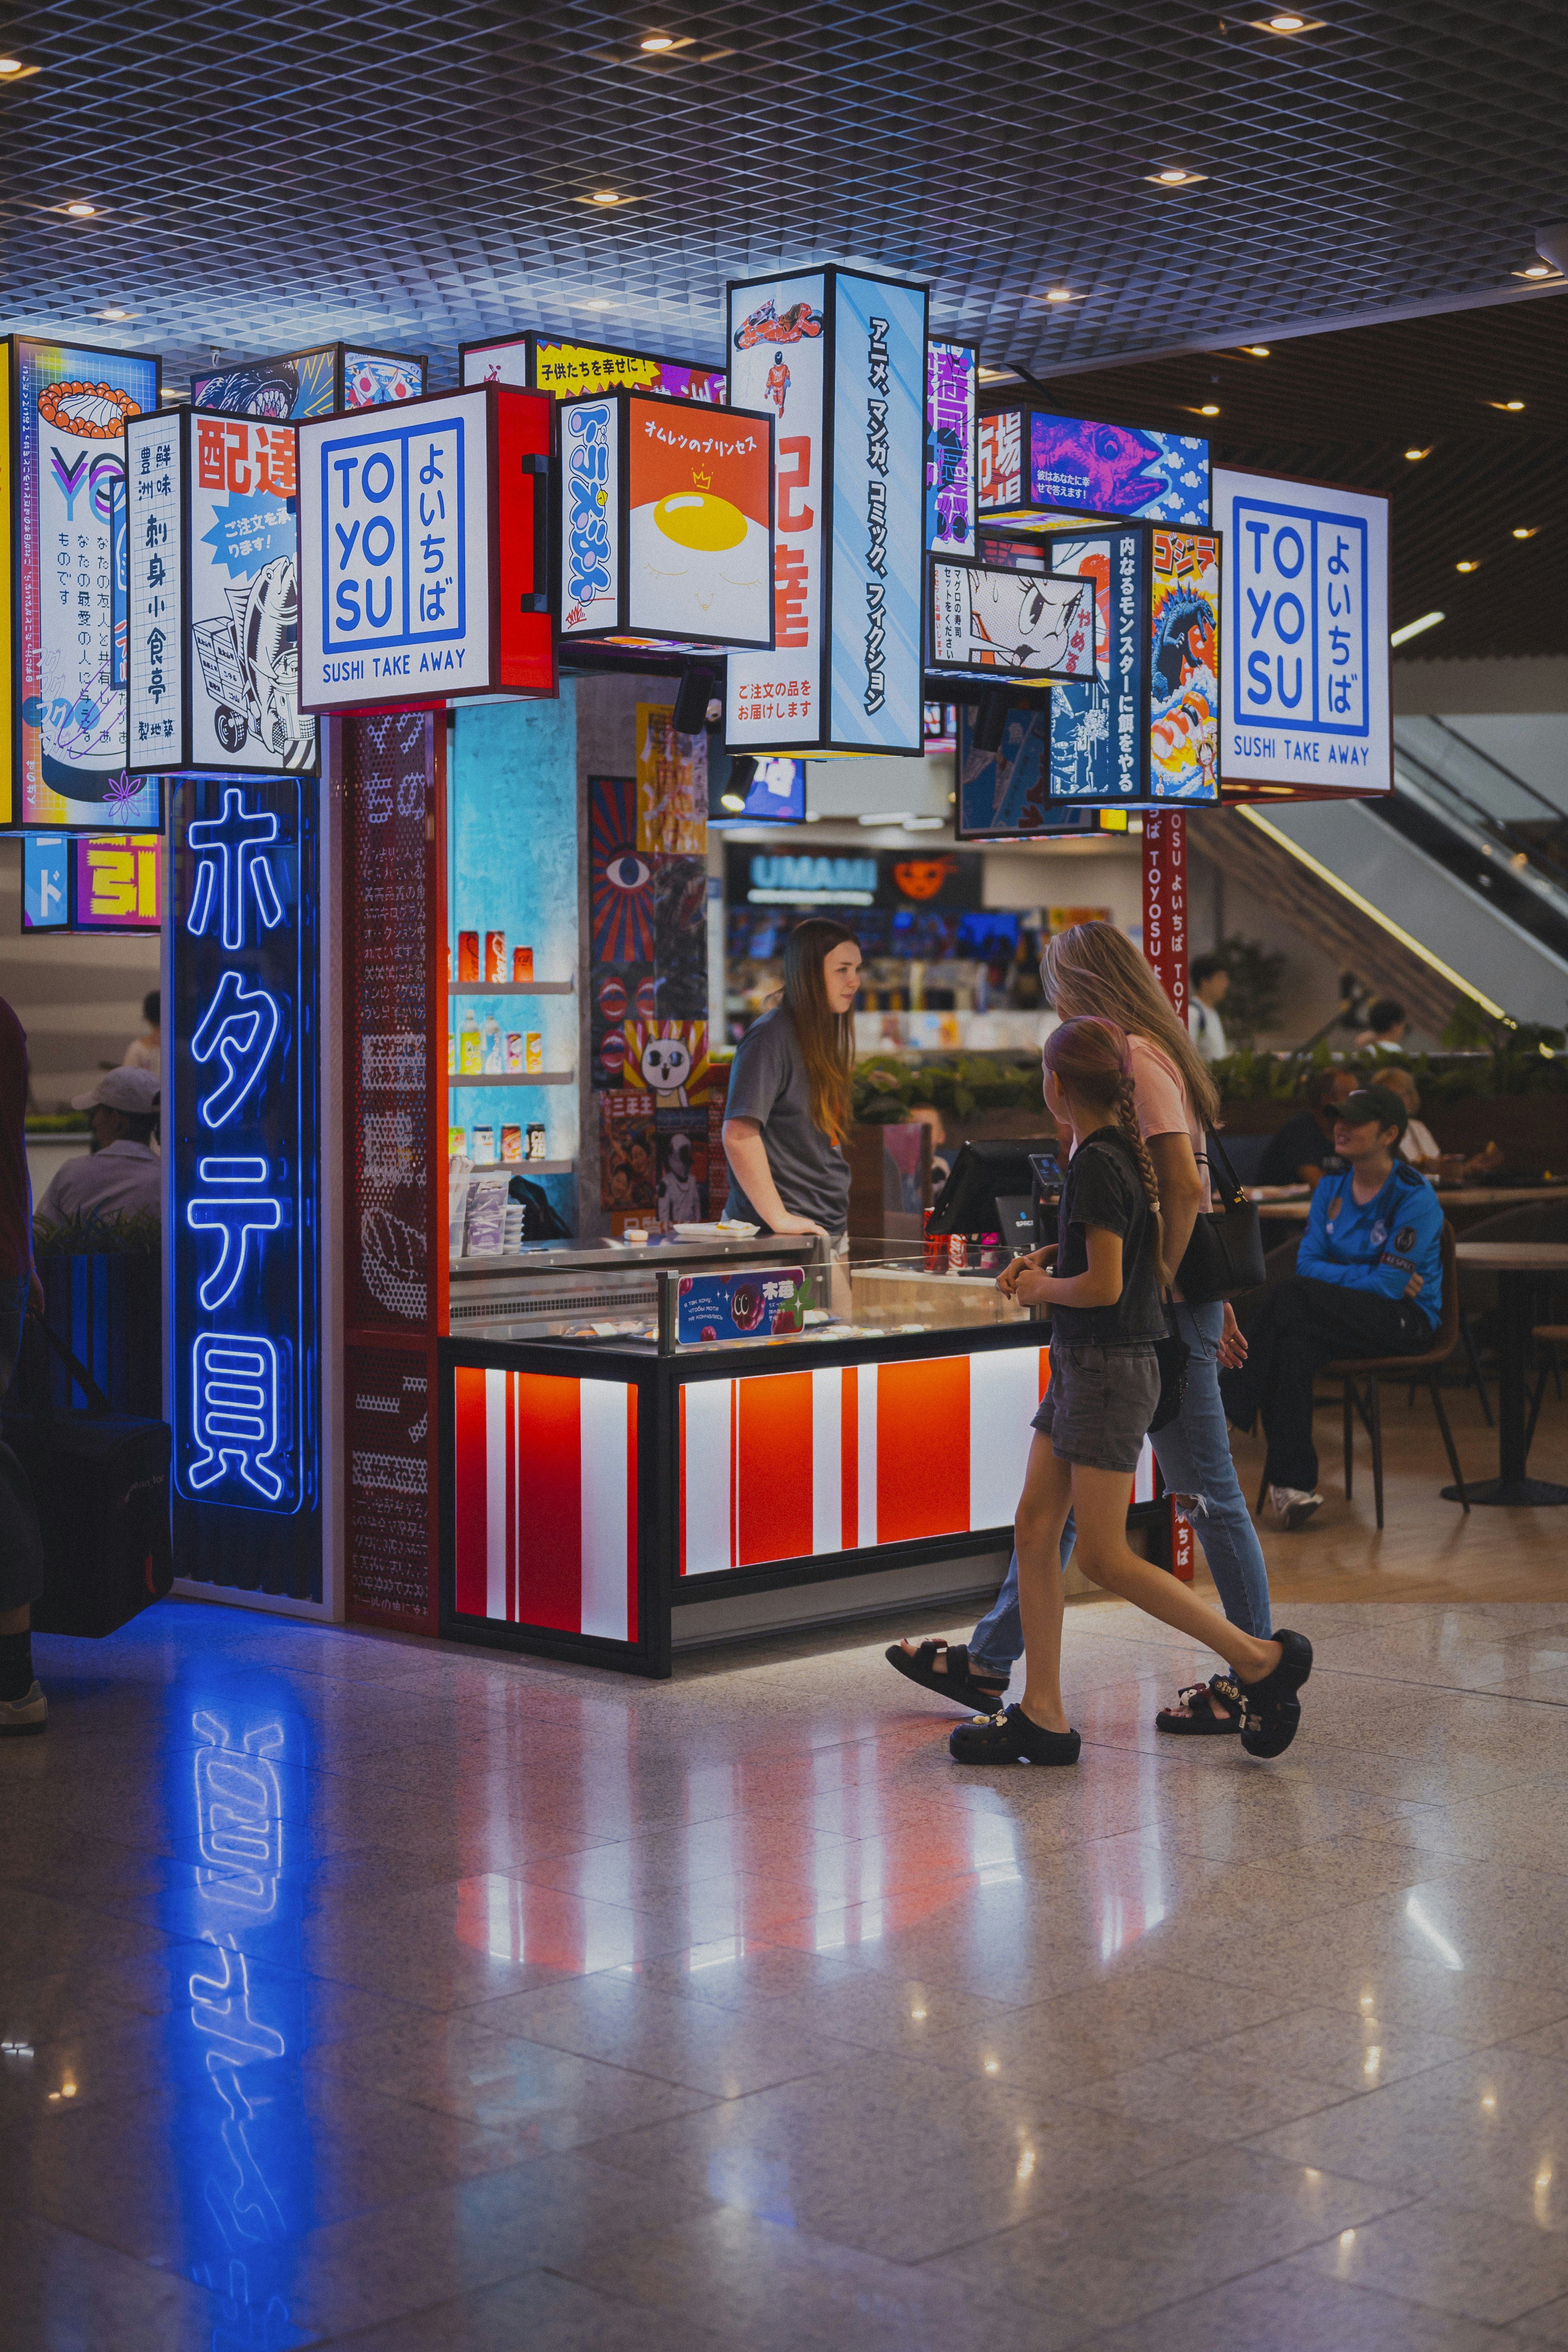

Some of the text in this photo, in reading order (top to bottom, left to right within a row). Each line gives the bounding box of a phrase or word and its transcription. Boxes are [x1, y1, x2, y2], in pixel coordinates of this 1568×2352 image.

[645, 420, 757, 456] オムレツのプリンセス
[334, 452, 394, 508] TO
[1037, 469, 1090, 488] 彼はあなたに幸
[335, 515, 395, 570] YO
[419, 443, 453, 622] よいちば
[1153, 532, 1216, 577] ゴジラ
[1246, 520, 1304, 579] TO
[58, 533, 71, 605] ものです
[146, 514, 167, 704] 刺身小食亭
[335, 576, 392, 632] SU
[944, 567, 954, 660] セットをください
[1247, 587, 1305, 645] YO
[1328, 535, 1358, 714] よいちば
[323, 648, 465, 683] SUSHI TAKE AWAY
[739, 680, 812, 700] ご注文の品を
[1118, 537, 1136, 792] 内なるモンスターに餌をやる
[1247, 650, 1302, 709] SU
[738, 701, 811, 720] お届けします
[1234, 735, 1369, 766] SUSHI TAKE AWAY
[1171, 810, 1181, 866] OSU
[87, 835, 158, 918] 引
[1148, 851, 1161, 956] TOYOSU
[1172, 875, 1183, 952] よいちば
[187, 789, 282, 1500] ホタテ貝
